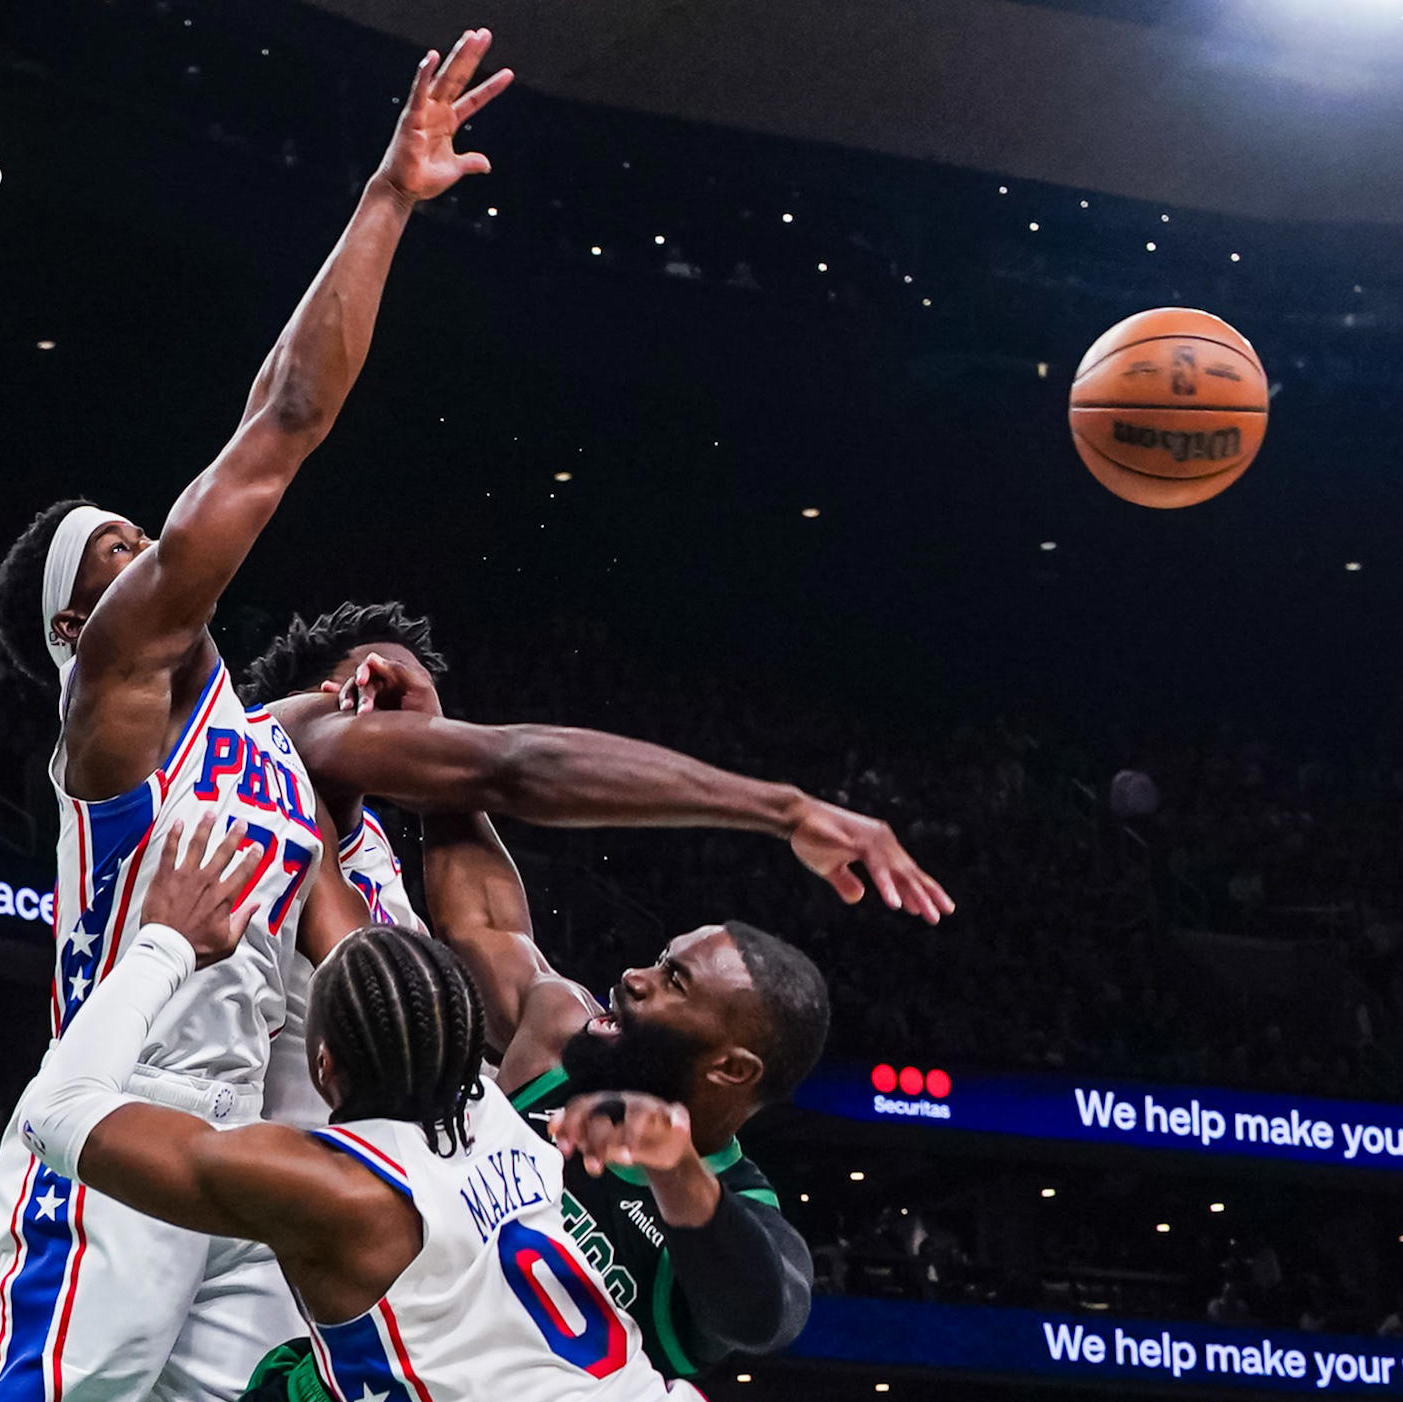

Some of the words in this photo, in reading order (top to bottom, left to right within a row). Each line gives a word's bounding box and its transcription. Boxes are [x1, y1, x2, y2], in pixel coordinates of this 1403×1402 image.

[872, 1093, 952, 1121] Securitas
[1073, 1087, 1138, 1131] We
[1143, 1094, 1227, 1147] help
[1233, 1108, 1335, 1150] make
[459, 1148, 553, 1245] MAXEY
[619, 1199, 666, 1248] Amica
[497, 1218, 628, 1380] 0
[1042, 1321, 1107, 1364] We
[1114, 1327, 1198, 1378] help
[1204, 1338, 1308, 1379] make
[1313, 1351, 1396, 1389] your
